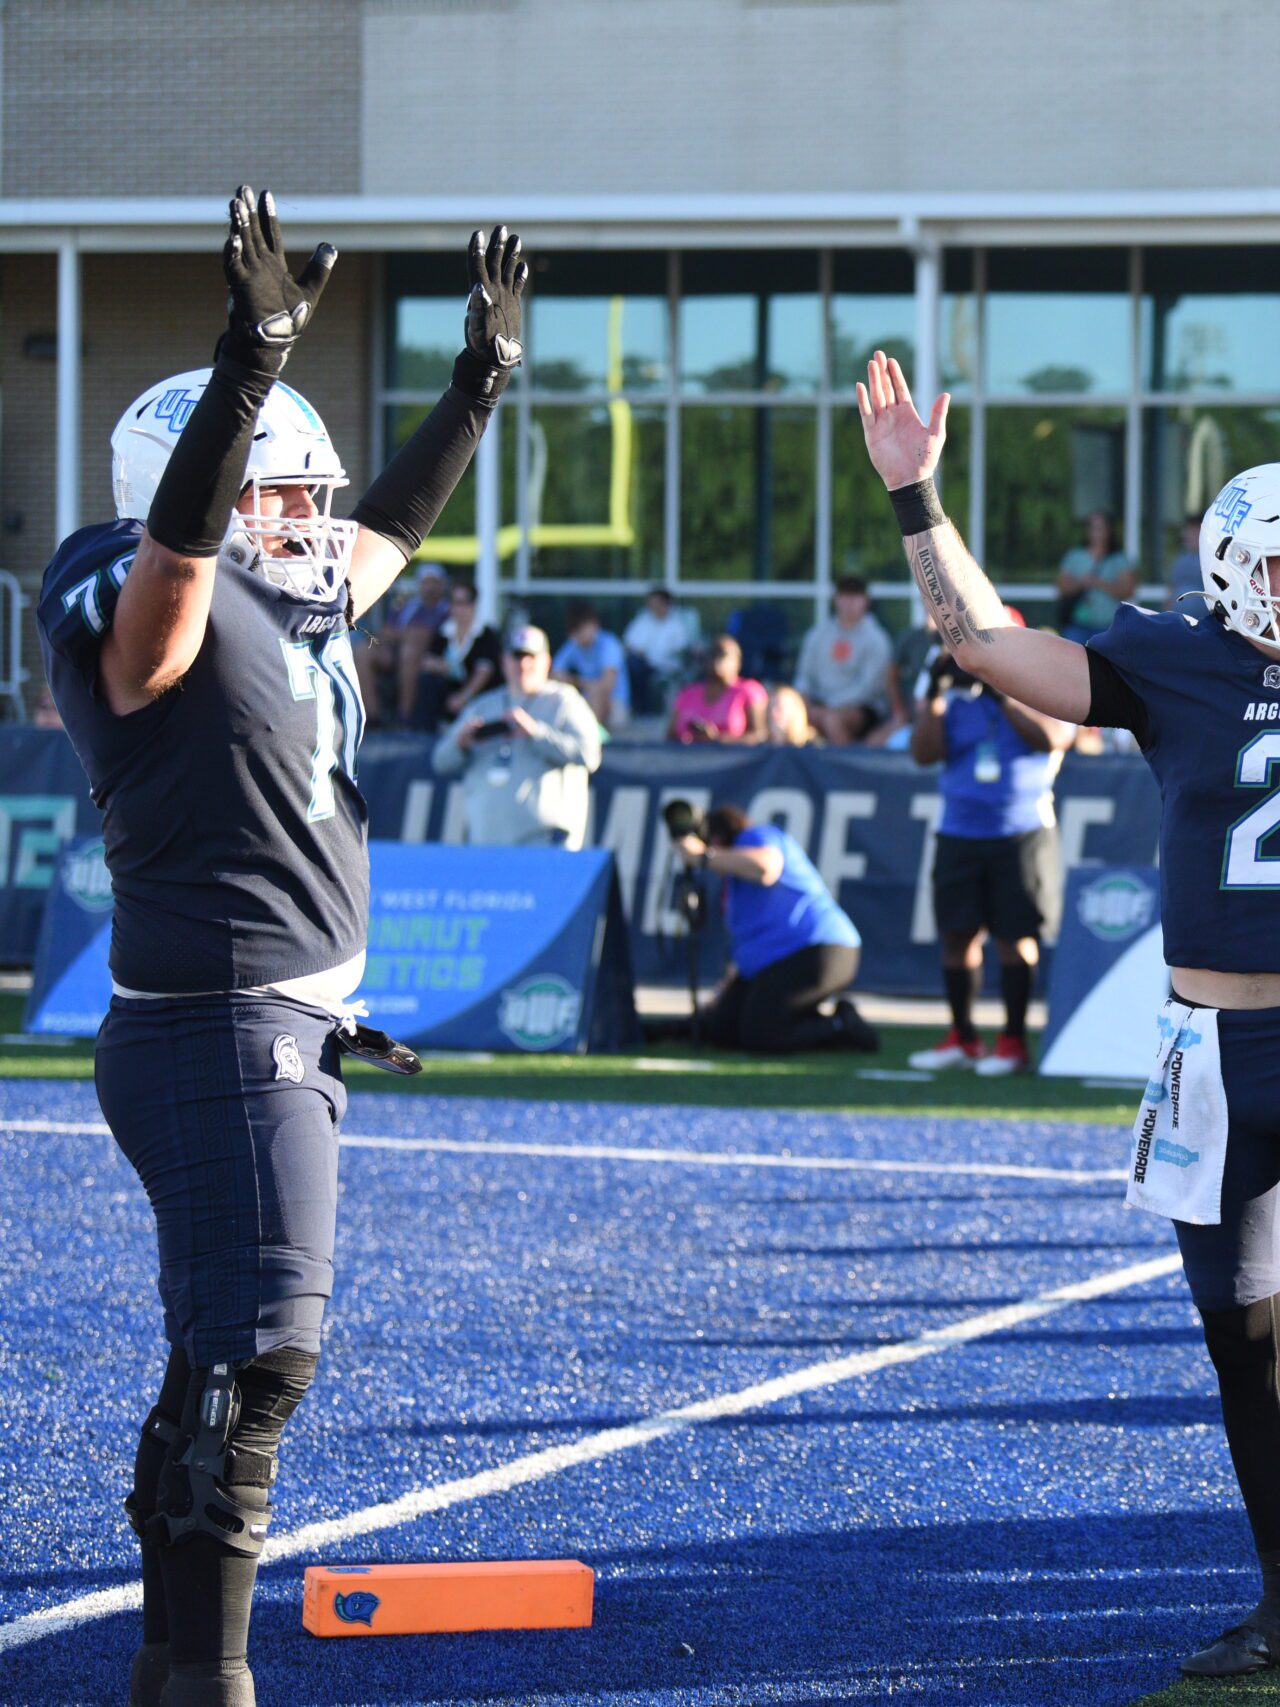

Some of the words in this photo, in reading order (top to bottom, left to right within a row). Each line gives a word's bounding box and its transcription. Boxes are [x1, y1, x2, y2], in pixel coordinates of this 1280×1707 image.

[943, 613, 951, 621] V
[950, 624, 964, 645] VIII
[381, 889, 437, 909] WEST
[444, 889, 536, 912] FLORIDA
[367, 914, 490, 949] NAUT
[1170, 1050, 1184, 1130] POWERADE
[1133, 1108, 1158, 1185] POWERADE
